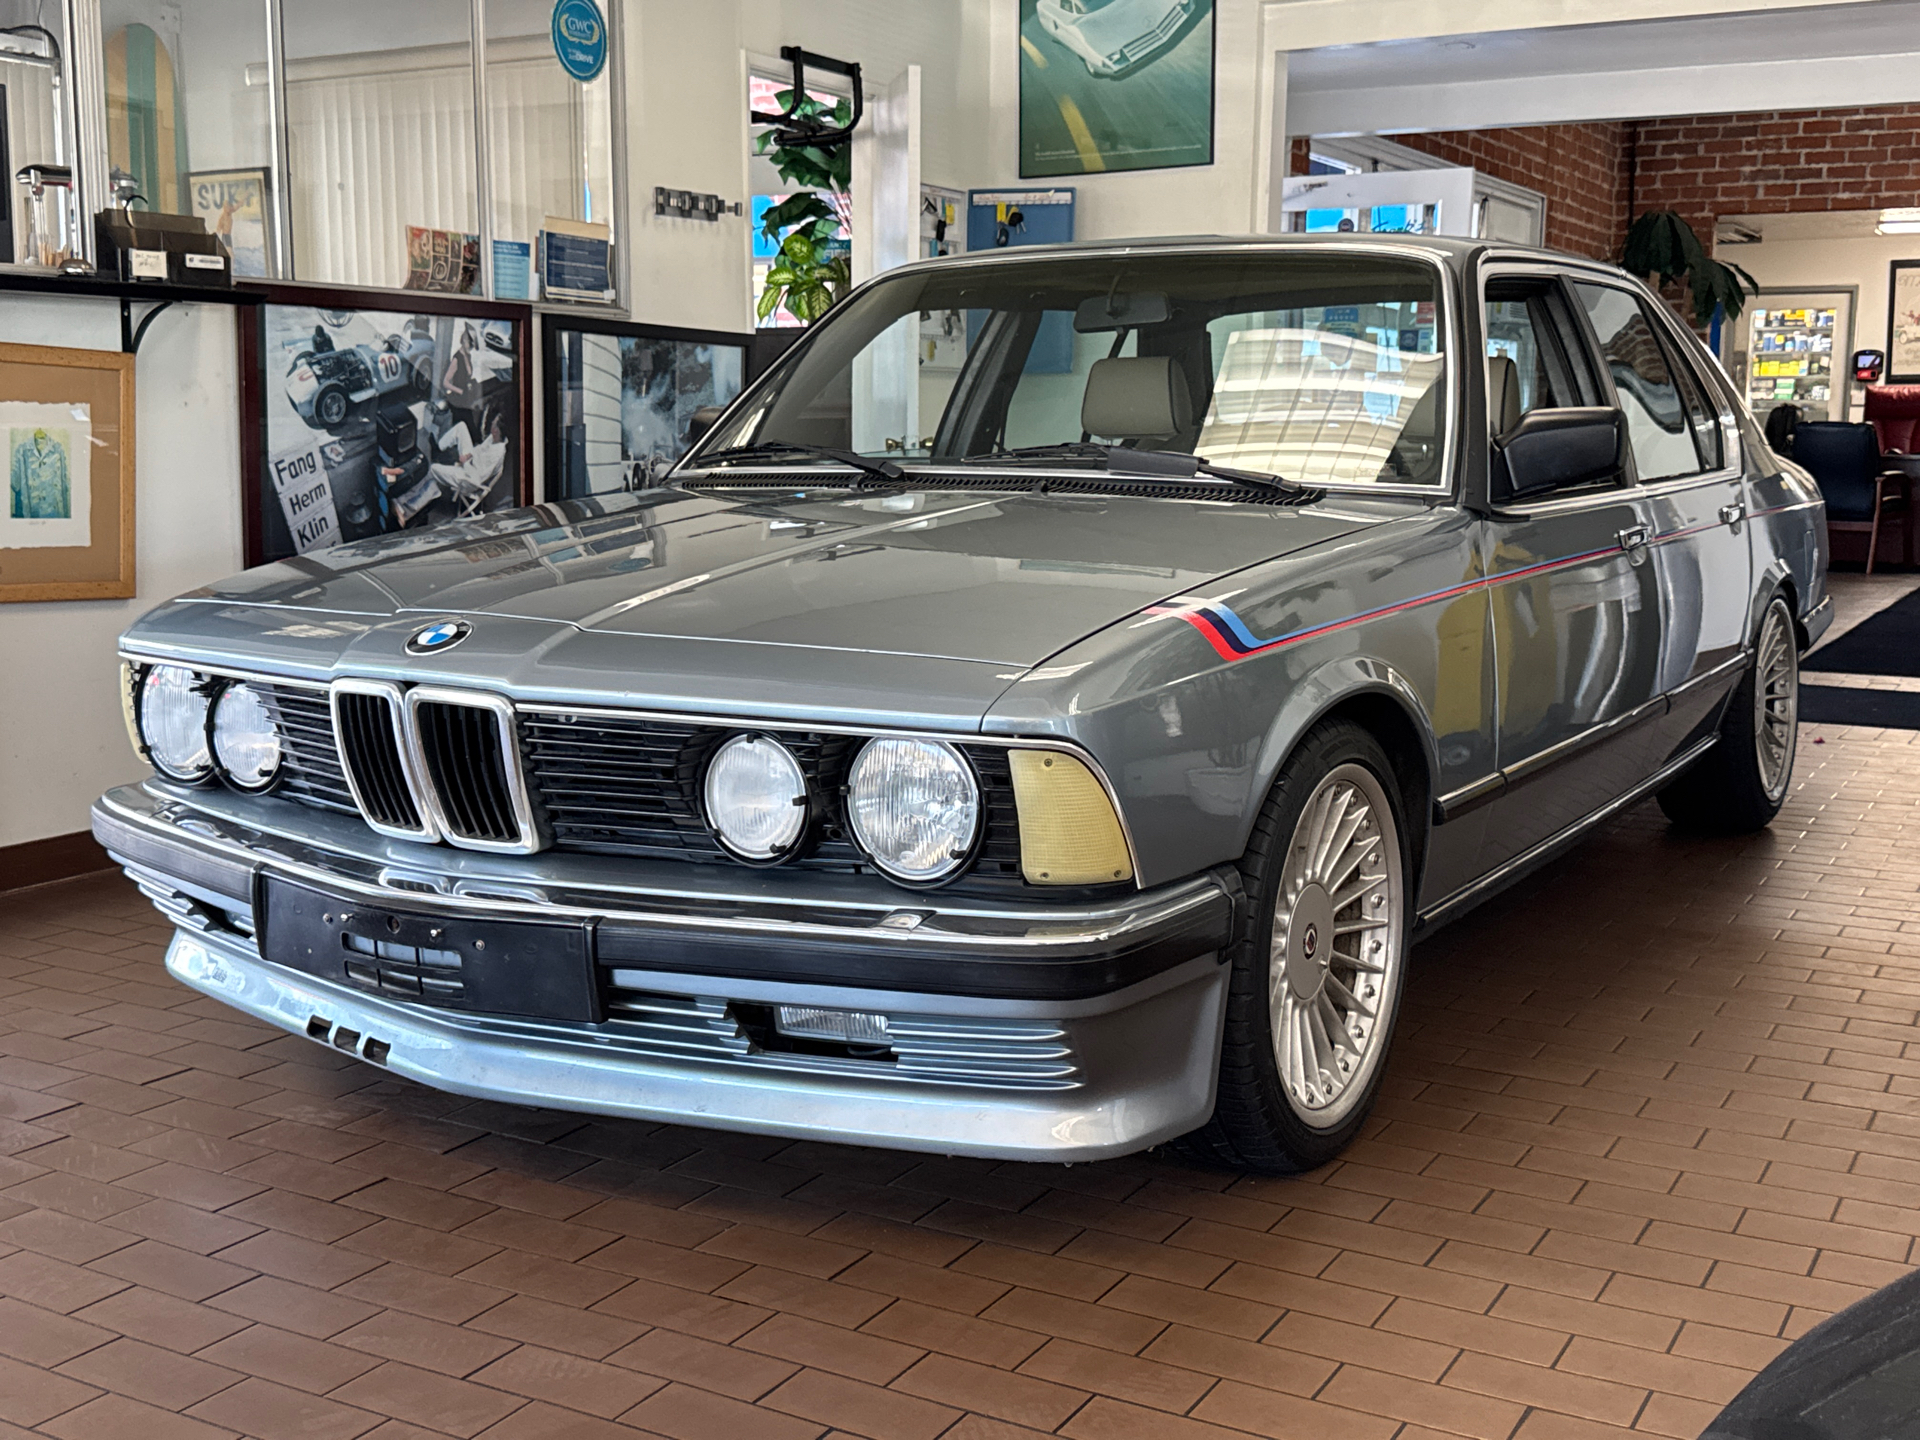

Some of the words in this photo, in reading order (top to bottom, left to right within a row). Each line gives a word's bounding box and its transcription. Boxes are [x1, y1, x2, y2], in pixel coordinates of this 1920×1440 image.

[568, 17, 591, 34] GWC
[380, 355, 399, 379] 10
[274, 451, 317, 487] Fang
[289, 482, 327, 516] Herm
[297, 516, 329, 549] Klin
